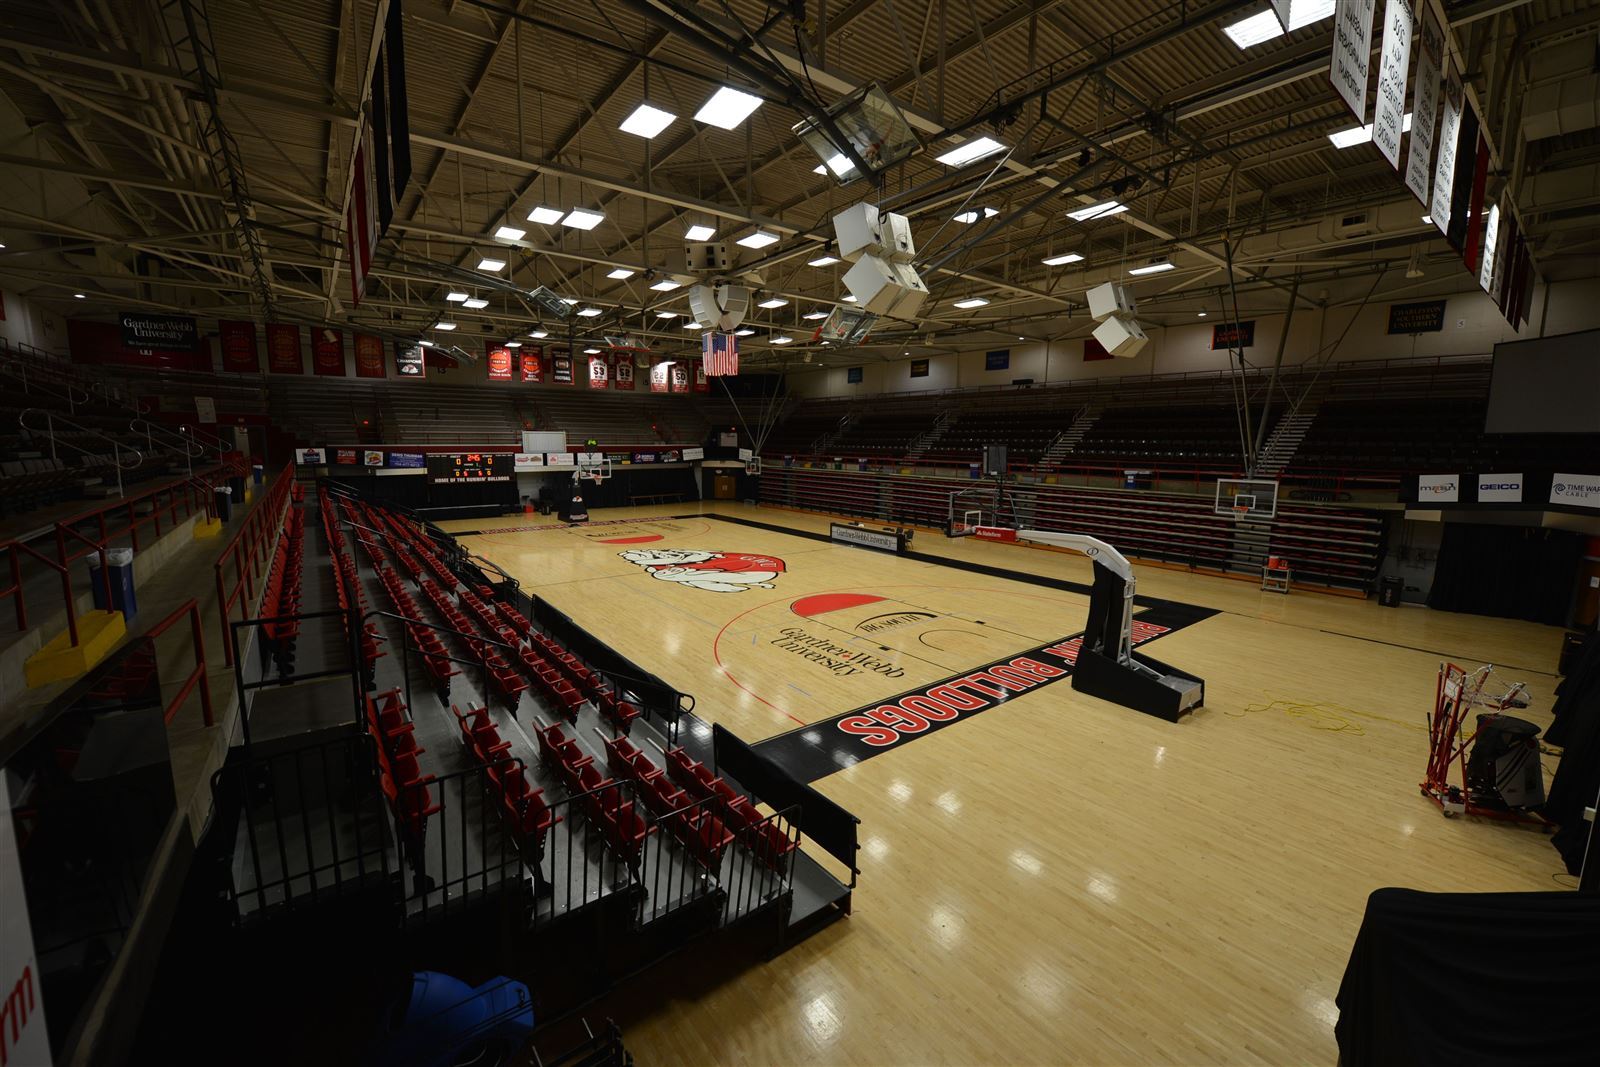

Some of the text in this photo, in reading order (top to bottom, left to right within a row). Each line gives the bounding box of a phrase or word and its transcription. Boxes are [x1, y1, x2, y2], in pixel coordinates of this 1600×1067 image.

[134, 328, 184, 340] University
[593, 366, 604, 376] 53
[619, 368, 630, 377] 52
[676, 373, 686, 381] 50
[883, 614, 920, 628] SOUTH
[771, 636, 864, 676] University
[837, 656, 1068, 747] BULLDOGS
